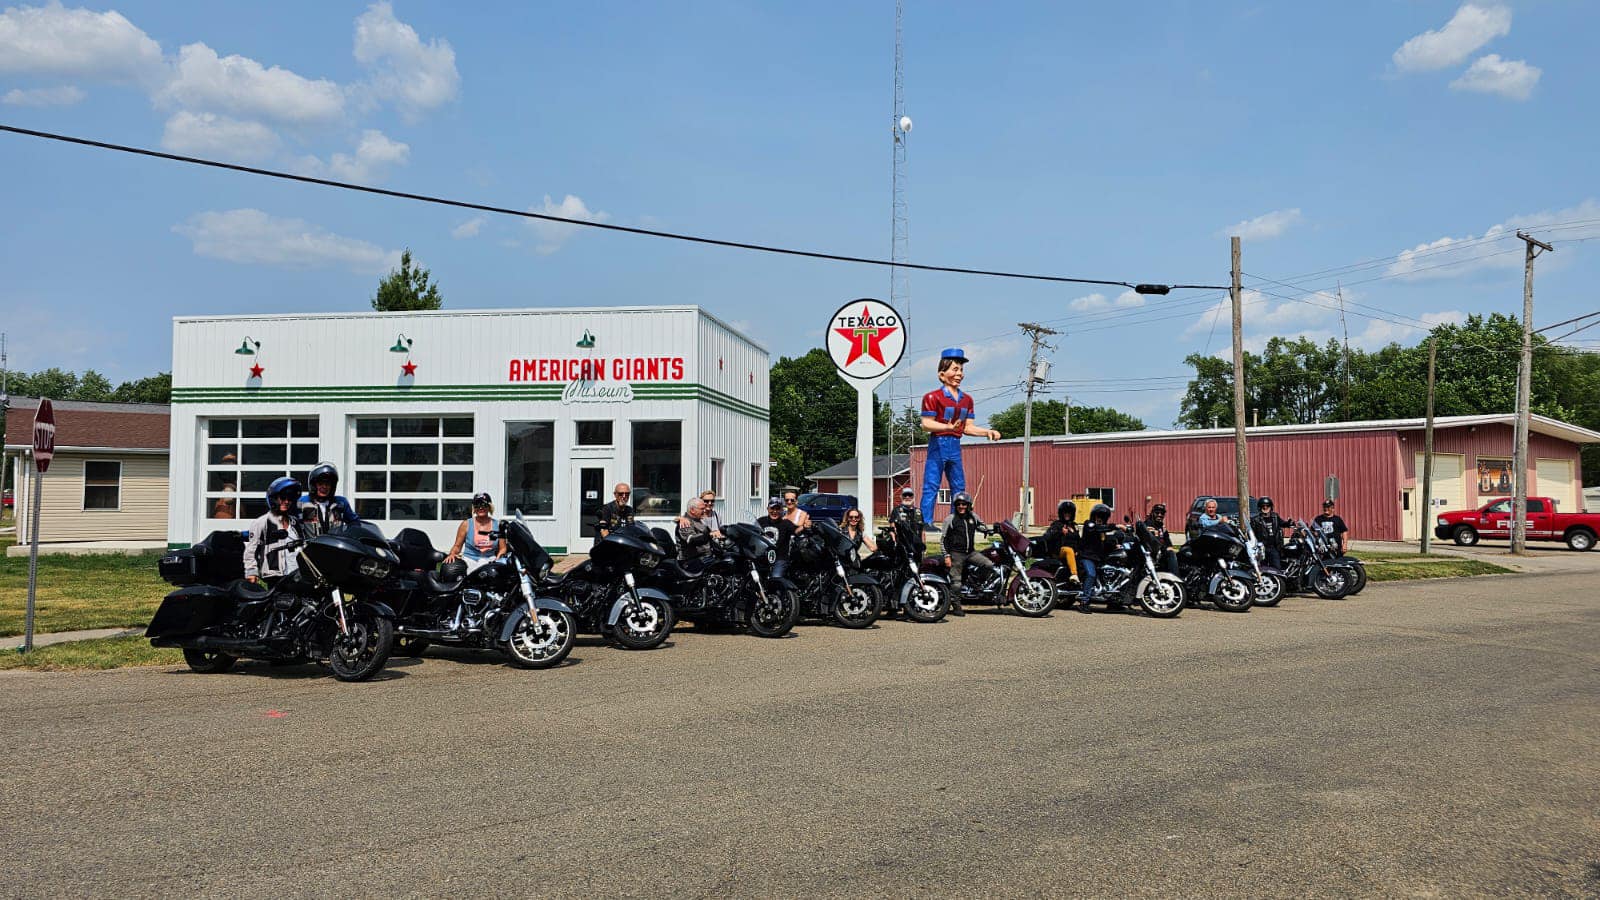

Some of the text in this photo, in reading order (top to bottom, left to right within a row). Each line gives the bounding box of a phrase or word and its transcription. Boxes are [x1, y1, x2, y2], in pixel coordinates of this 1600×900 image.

[838, 316, 897, 328] TEXACO
[853, 329, 878, 354] T
[509, 357, 684, 382] AMERICAN GIANTS
[565, 378, 630, 398] Museum
[34, 422, 55, 449] STOP
[1496, 520, 1534, 528] FIE
